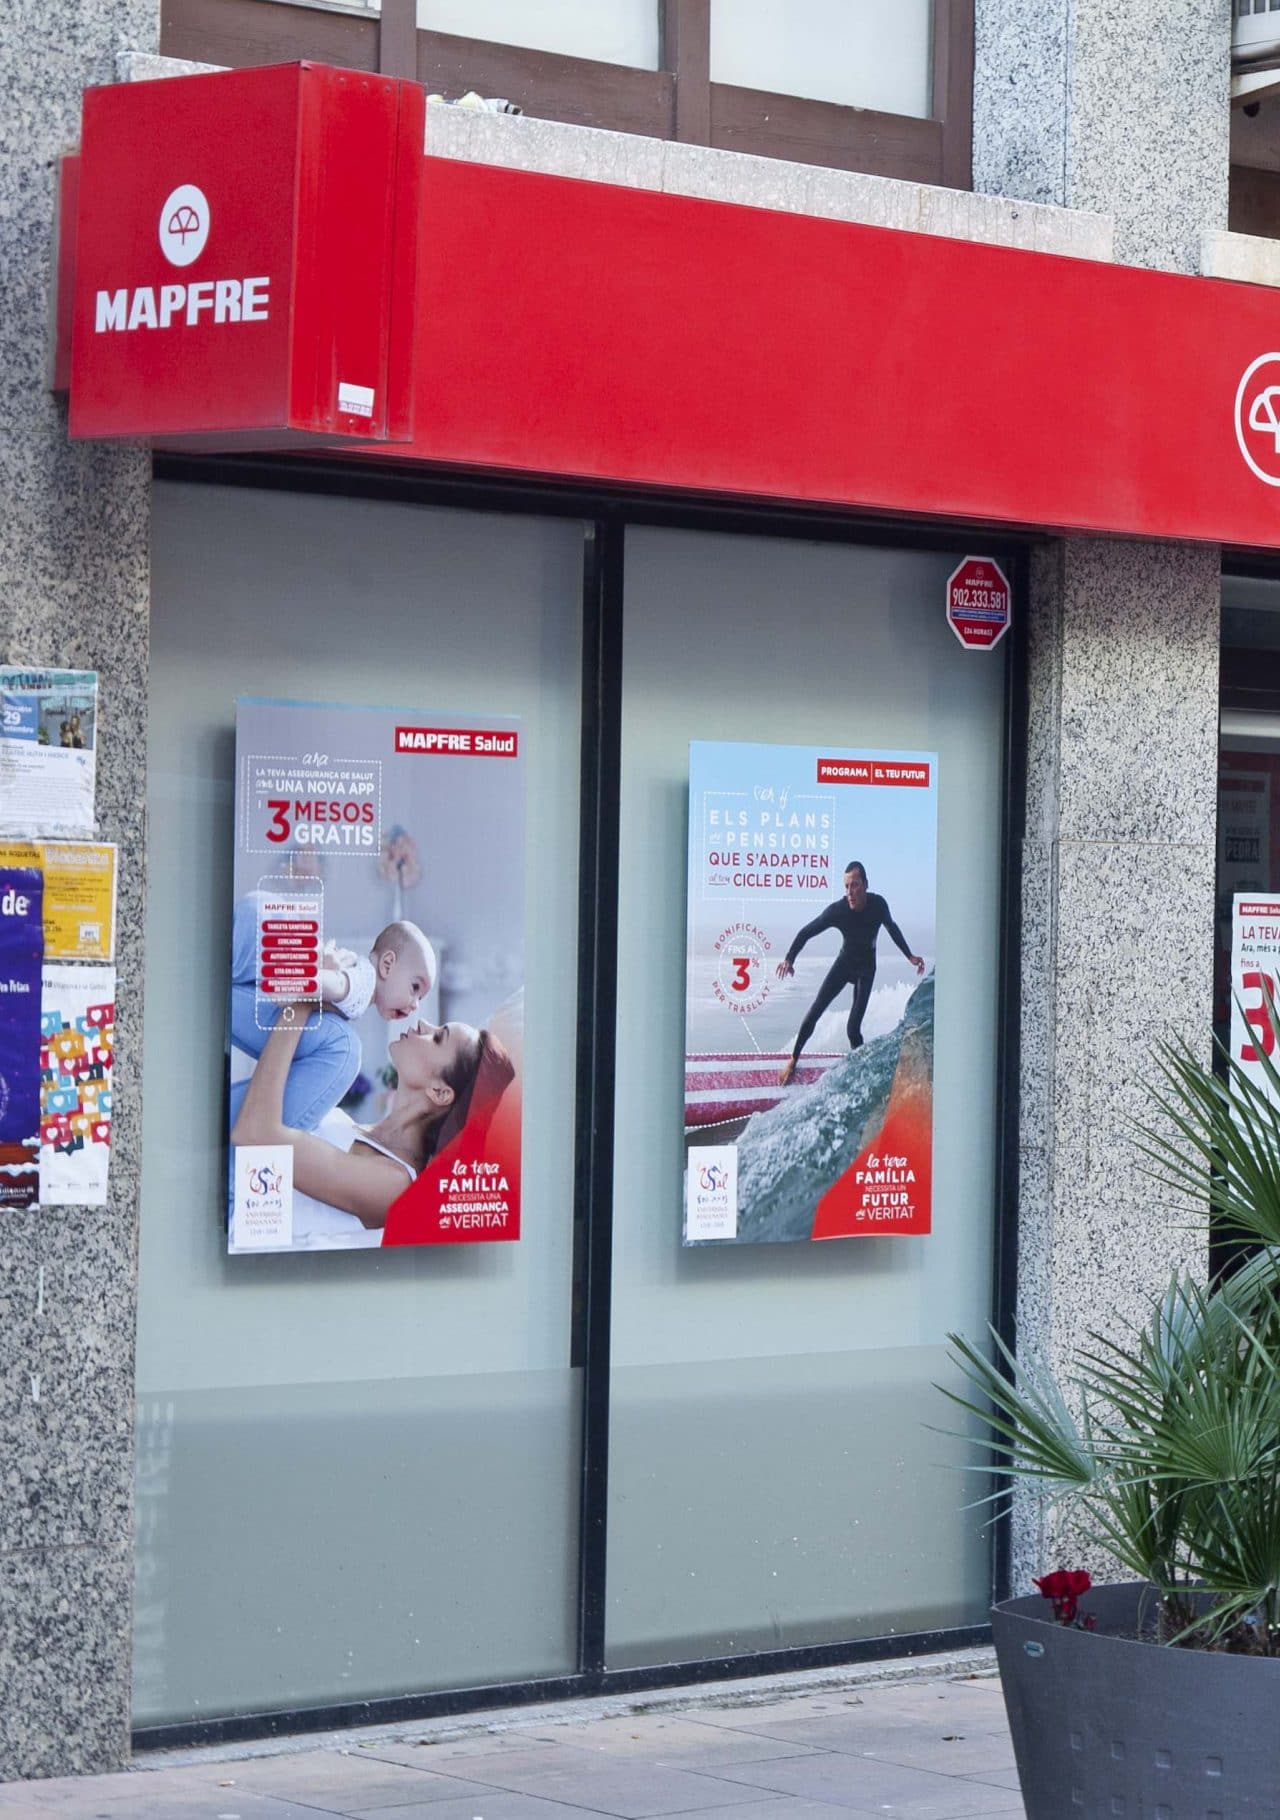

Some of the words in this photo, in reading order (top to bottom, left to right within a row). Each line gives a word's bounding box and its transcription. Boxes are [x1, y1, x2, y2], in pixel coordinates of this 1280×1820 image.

[95, 276, 270, 333] MAPFRE
[952, 588, 1006, 609] 902.333.581
[3, 711, 21, 726] 29
[399, 732, 471, 750] MAPFRE
[474, 735, 514, 752] Salud
[256, 768, 265, 777] LA
[267, 769, 286, 777] TEVA
[288, 770, 339, 780] ASSEGURANÇA
[351, 772, 374, 780] SALUT
[821, 766, 868, 778] PROGRAMA
[875, 769, 885, 778] EL
[886, 769, 900, 779] TEU
[901, 770, 926, 780] FUTUR
[275, 780, 304, 793] UNA
[307, 781, 345, 794] NOVA
[349, 782, 375, 795] APP
[266, 800, 291, 843] 3
[295, 800, 374, 823] MESOS
[710, 809, 748, 826] ELS
[761, 811, 830, 829] PLANS
[294, 823, 374, 845] GRATIS
[726, 831, 829, 849] PENSIONS
[709, 852, 740, 866] QUE
[746, 853, 829, 868] S'ADAPTEN
[733, 873, 771, 887] CICLE
[775, 873, 793, 887] DE
[797, 875, 828, 888] VIDA
[2, 889, 30, 916] de
[1242, 905, 1268, 914] MAPFRE
[1242, 926, 1255, 939] LA
[1241, 943, 1255, 953] Ara,
[1257, 943, 1271, 952] més
[1241, 958, 1254, 968] fins
[732, 958, 750, 991] 3
[452, 1159, 467, 1175] la
[867, 1153, 880, 1168] la
[856, 1167, 916, 1184] FAMÍLIA
[440, 1175, 509, 1192] FAMÍLIA
[449, 1193, 485, 1201] NECESSITA
[487, 1192, 501, 1200] UNA
[862, 1192, 909, 1206] FUTUR
[440, 1202, 509, 1213] ASSEGURANÇA
[867, 1206, 915, 1220] VERITAT
[452, 1213, 509, 1229] VERITAT
